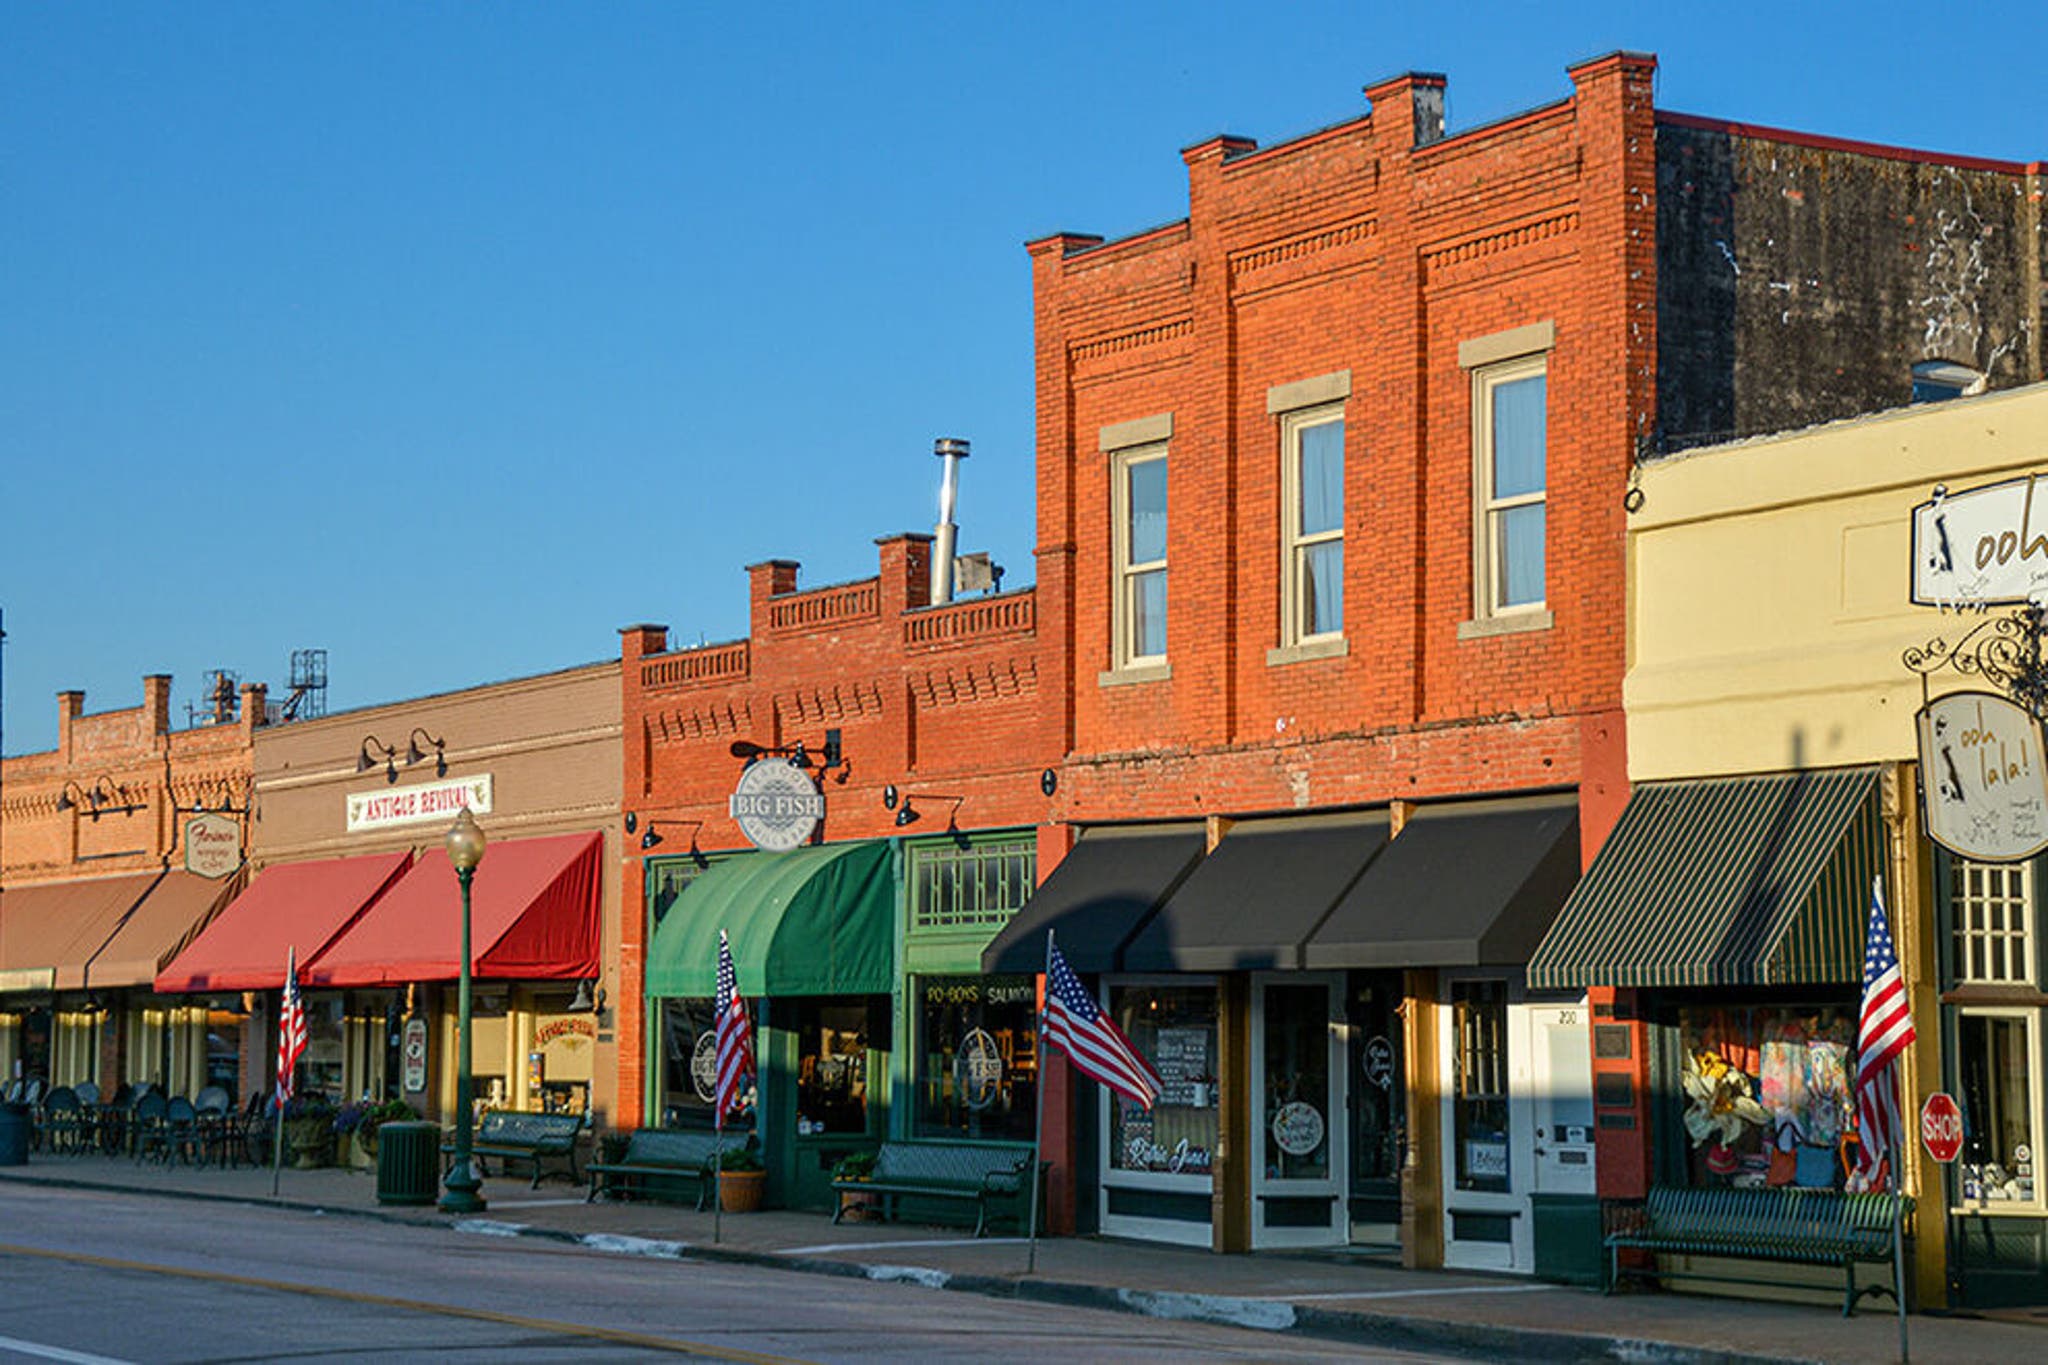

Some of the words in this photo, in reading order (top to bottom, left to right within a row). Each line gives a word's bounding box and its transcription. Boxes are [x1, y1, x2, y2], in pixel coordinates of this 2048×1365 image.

[1976, 473, 2048, 571] ooh
[1961, 701, 1996, 747] ooh
[366, 794, 416, 821] ANTIQUE
[421, 785, 468, 814] REVIVAL
[738, 795, 771, 816] BIG
[775, 795, 819, 816] FISH
[1559, 1011, 1577, 1024] 200
[1922, 1113, 1961, 1141] SHOP
